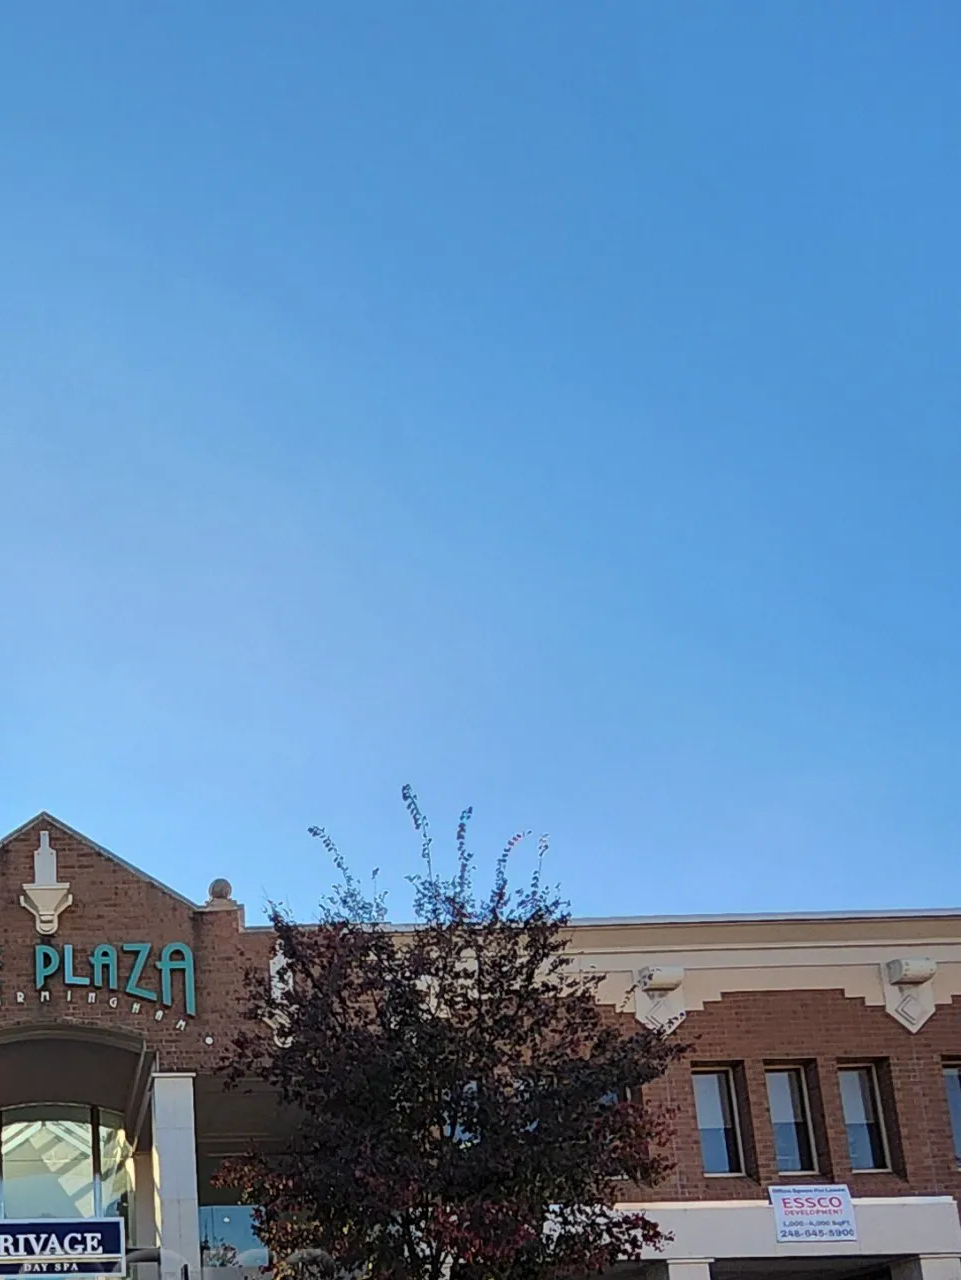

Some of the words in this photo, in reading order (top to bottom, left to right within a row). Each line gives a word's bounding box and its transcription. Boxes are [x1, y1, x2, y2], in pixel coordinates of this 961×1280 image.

[35, 942, 195, 1016] PLAZA
[781, 1197, 842, 1209] ESSCO
[24, 1263, 48, 1272] DAY
[55, 1262, 79, 1271] SPA
